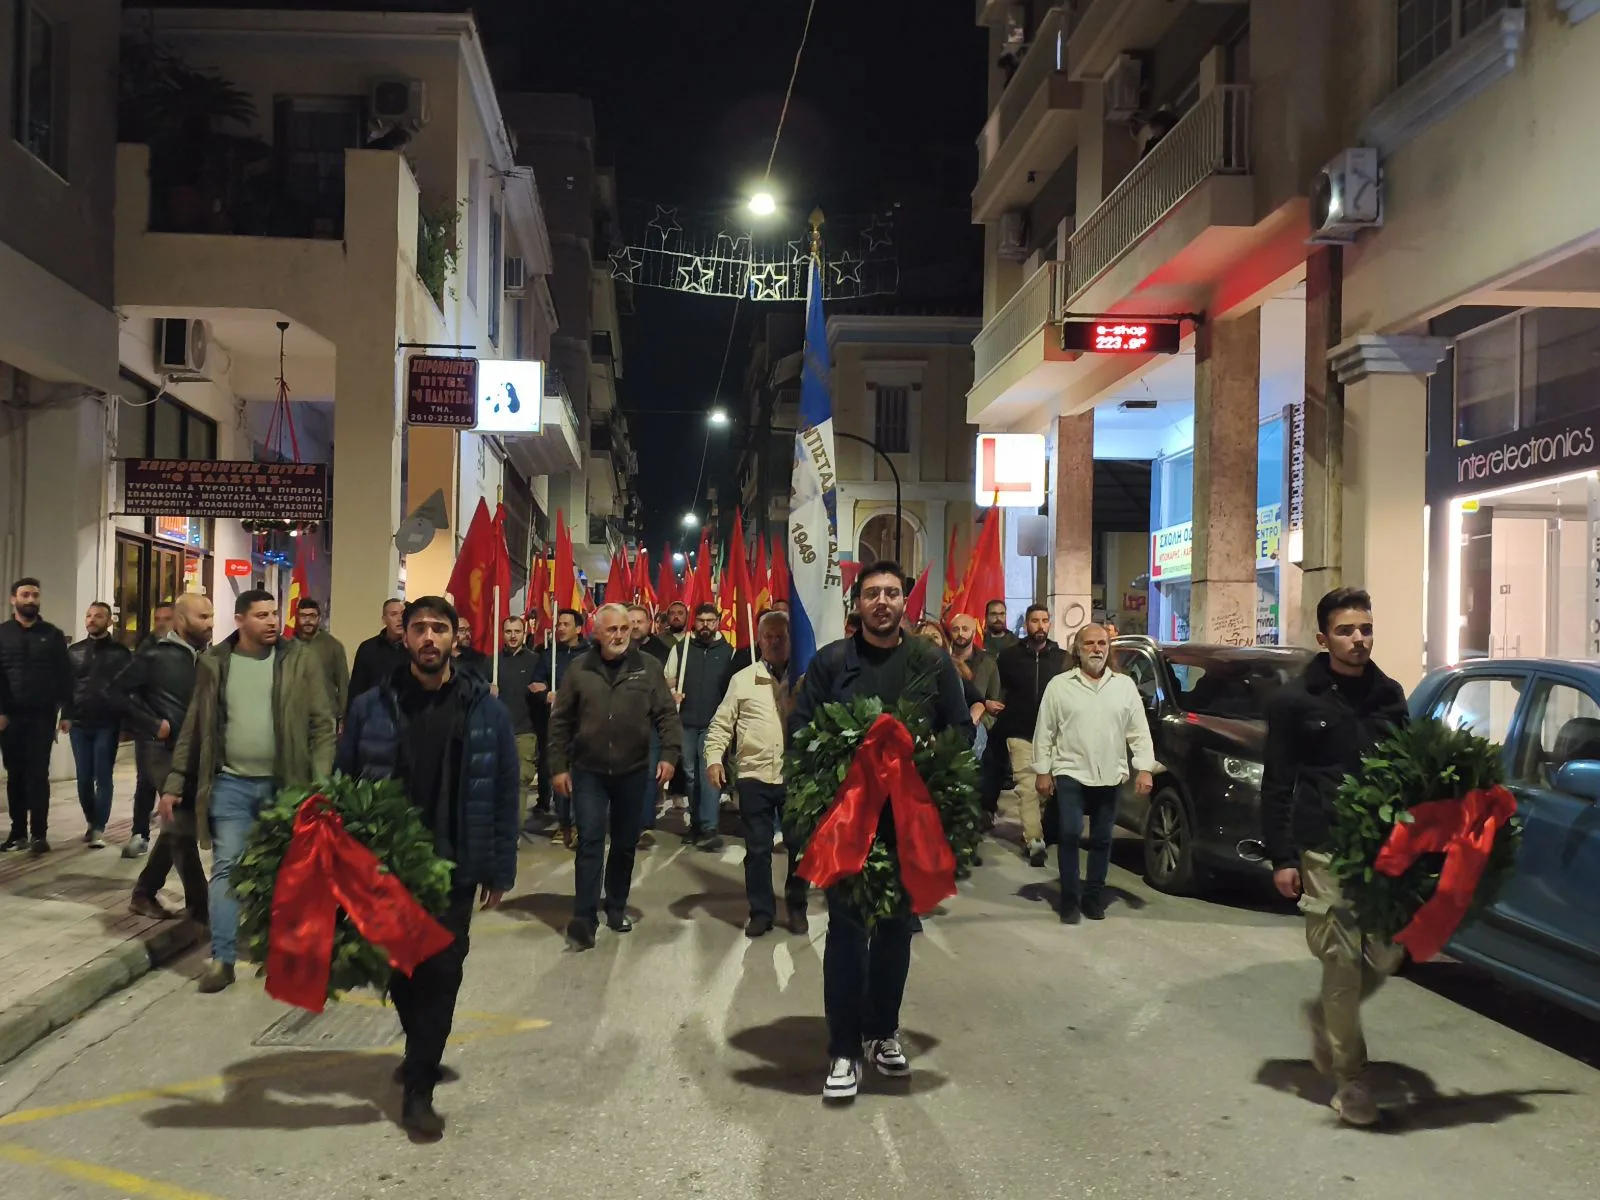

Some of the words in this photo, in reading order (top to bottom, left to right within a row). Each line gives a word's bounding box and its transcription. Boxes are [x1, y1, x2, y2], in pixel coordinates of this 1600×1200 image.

[420, 375, 466, 388] ΠΙΤΕΣ
[1458, 427, 1594, 482] interelectronics
[267, 464, 317, 475] ΠΙΤΕΣ
[983, 438, 1031, 492] L
[128, 482, 182, 490] ΤΥΡΟΠΙΤΑ
[199, 484, 252, 492] ΤΥΡΟΠΙΤΑ
[127, 491, 194, 499] ΣΠΑΝΑΚΟΠΙΤΑ
[202, 493, 257, 501] ΜΠΟΥΓΑΤΣΑ
[264, 494, 323, 503] ΚΑΣΕΡΟΠΙΤΑ
[273, 503, 323, 511] ΠΡΑΣΟΠΙΤΑ
[1159, 528, 1182, 548] ΣΧΟΛΗ
[1183, 525, 1192, 542] ΟΔ
[1256, 526, 1278, 539] ΕΝΤΡΟ
[791, 522, 817, 565] 1949
